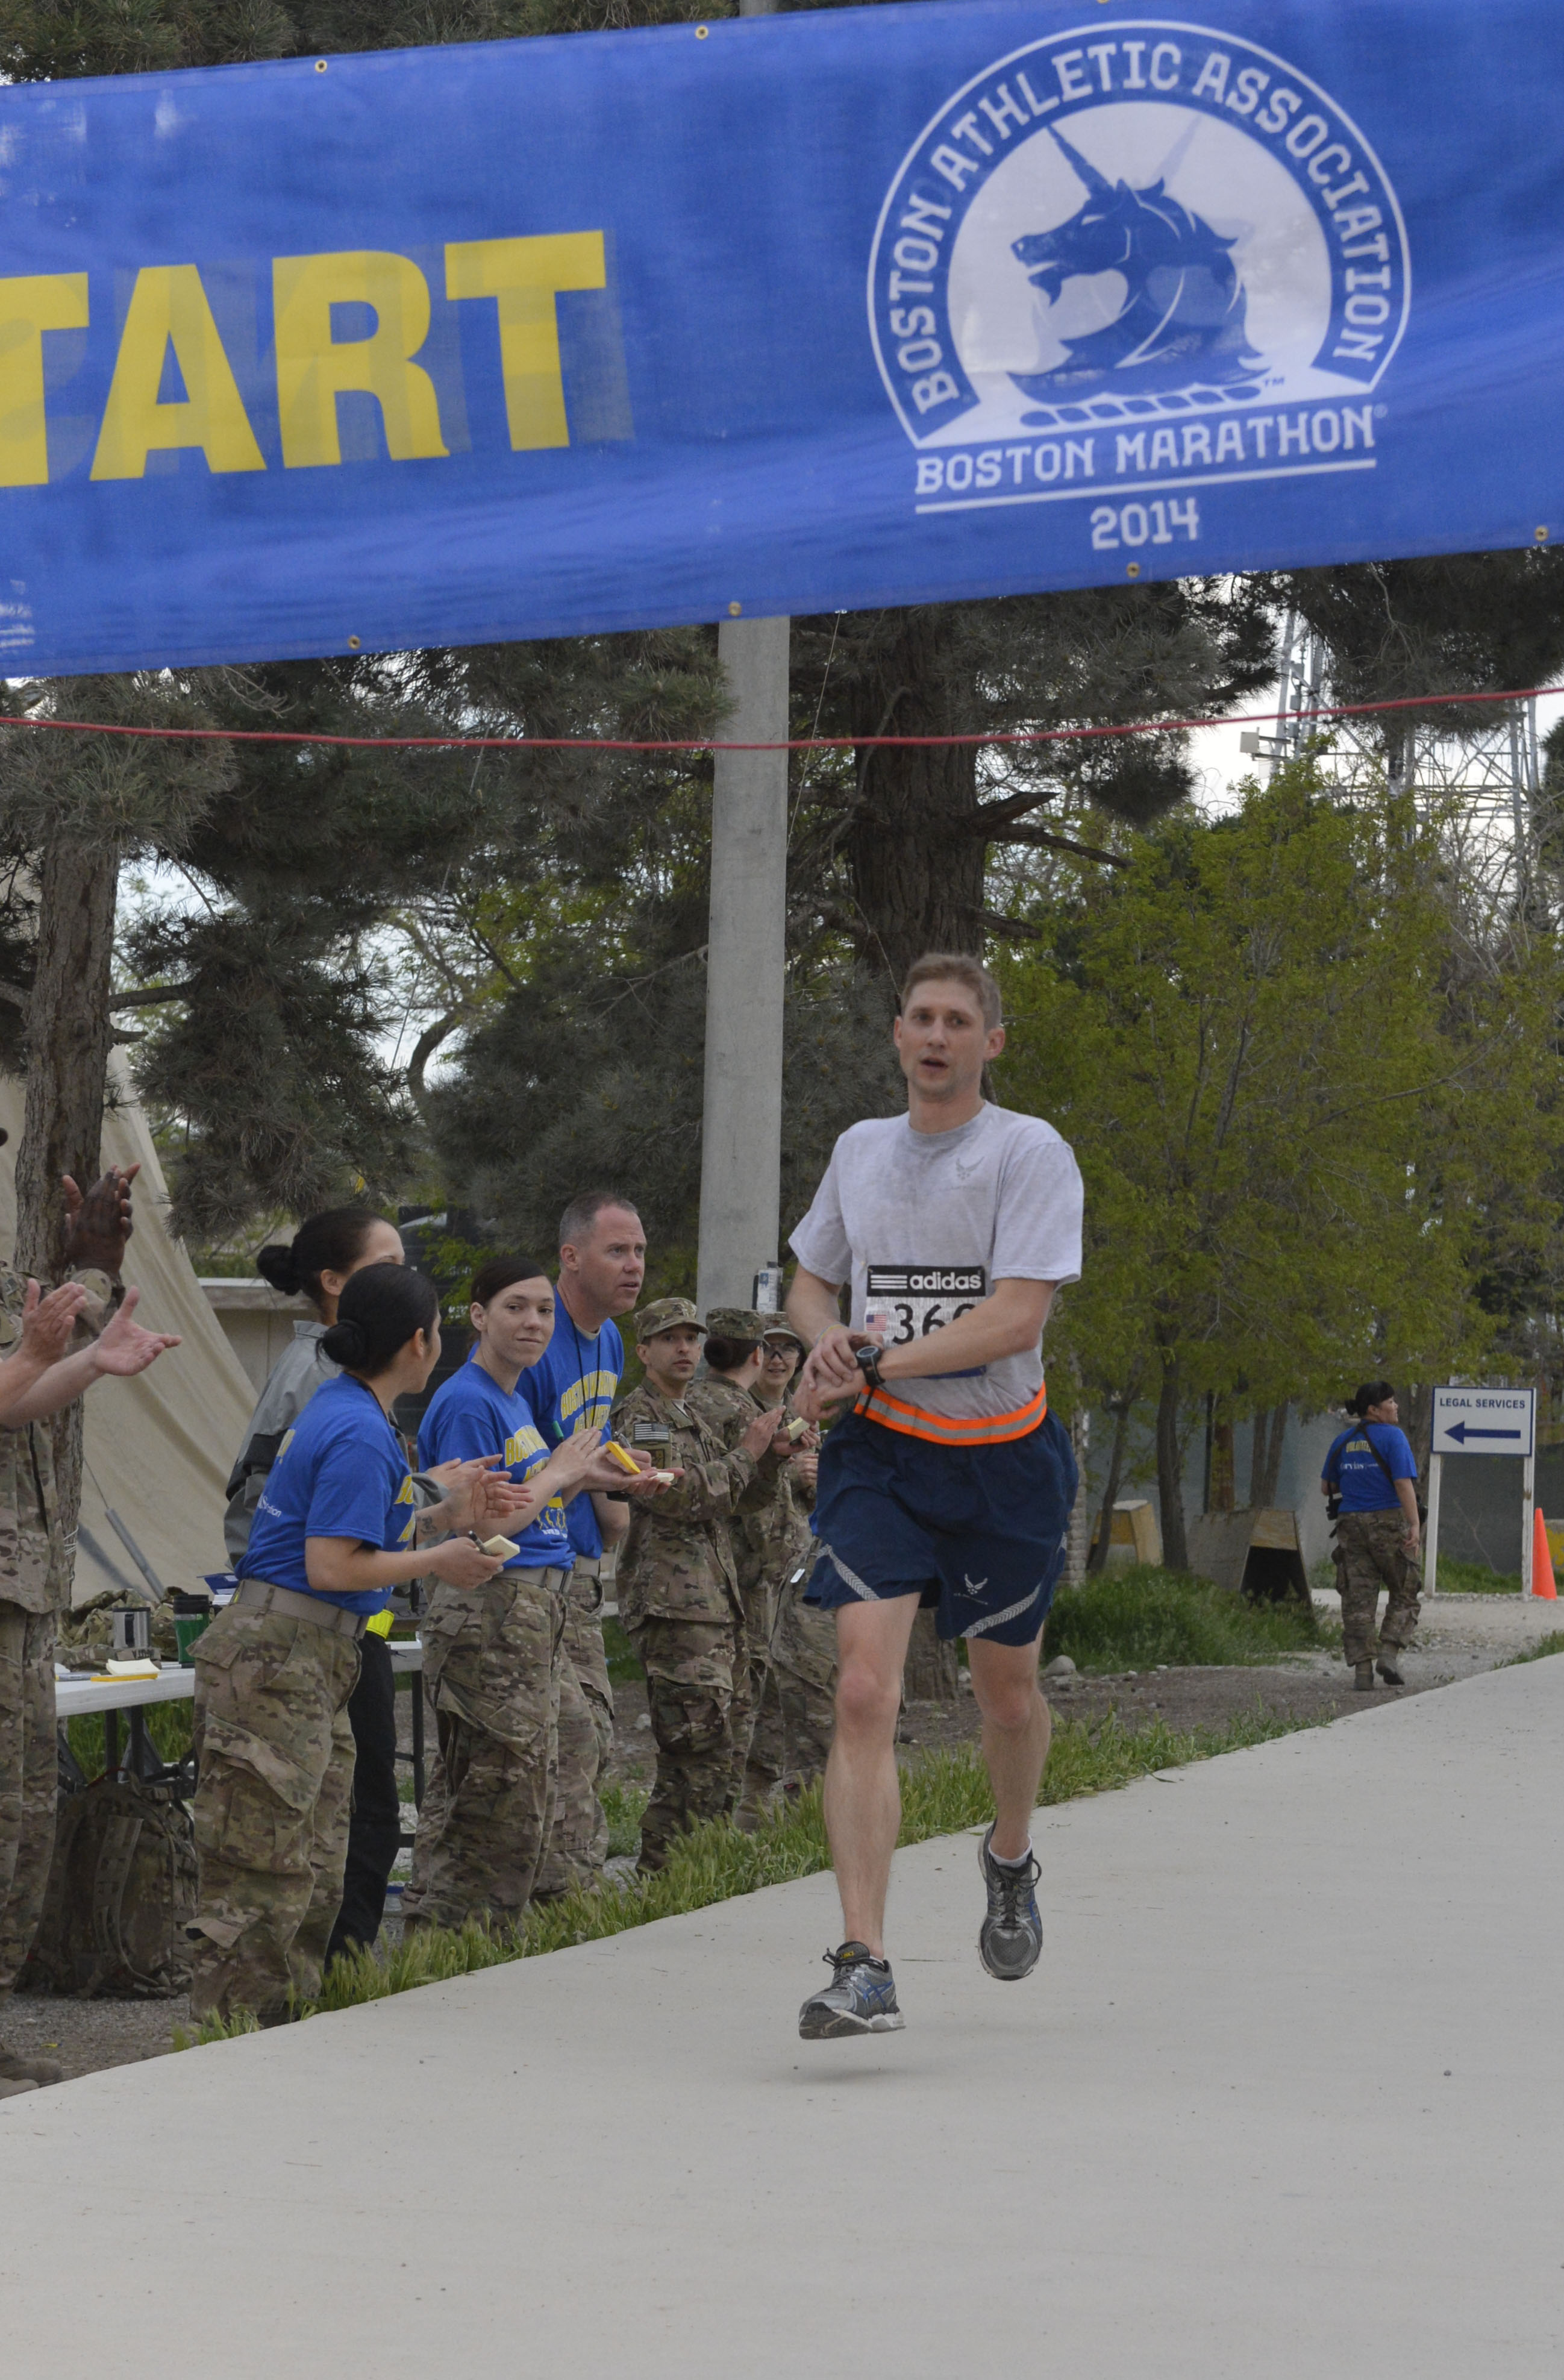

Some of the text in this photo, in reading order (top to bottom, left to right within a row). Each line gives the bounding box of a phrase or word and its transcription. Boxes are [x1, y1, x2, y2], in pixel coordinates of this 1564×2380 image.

[889, 42, 1391, 415] BOSTON ATHLETIC ASSOCIATION
[915, 405, 1375, 494] BOSTON MARATHON
[1090, 498, 1199, 550] 2014
[909, 1271, 981, 1290] adidas
[1440, 1397, 1525, 1409] LEGAL SERVICES
